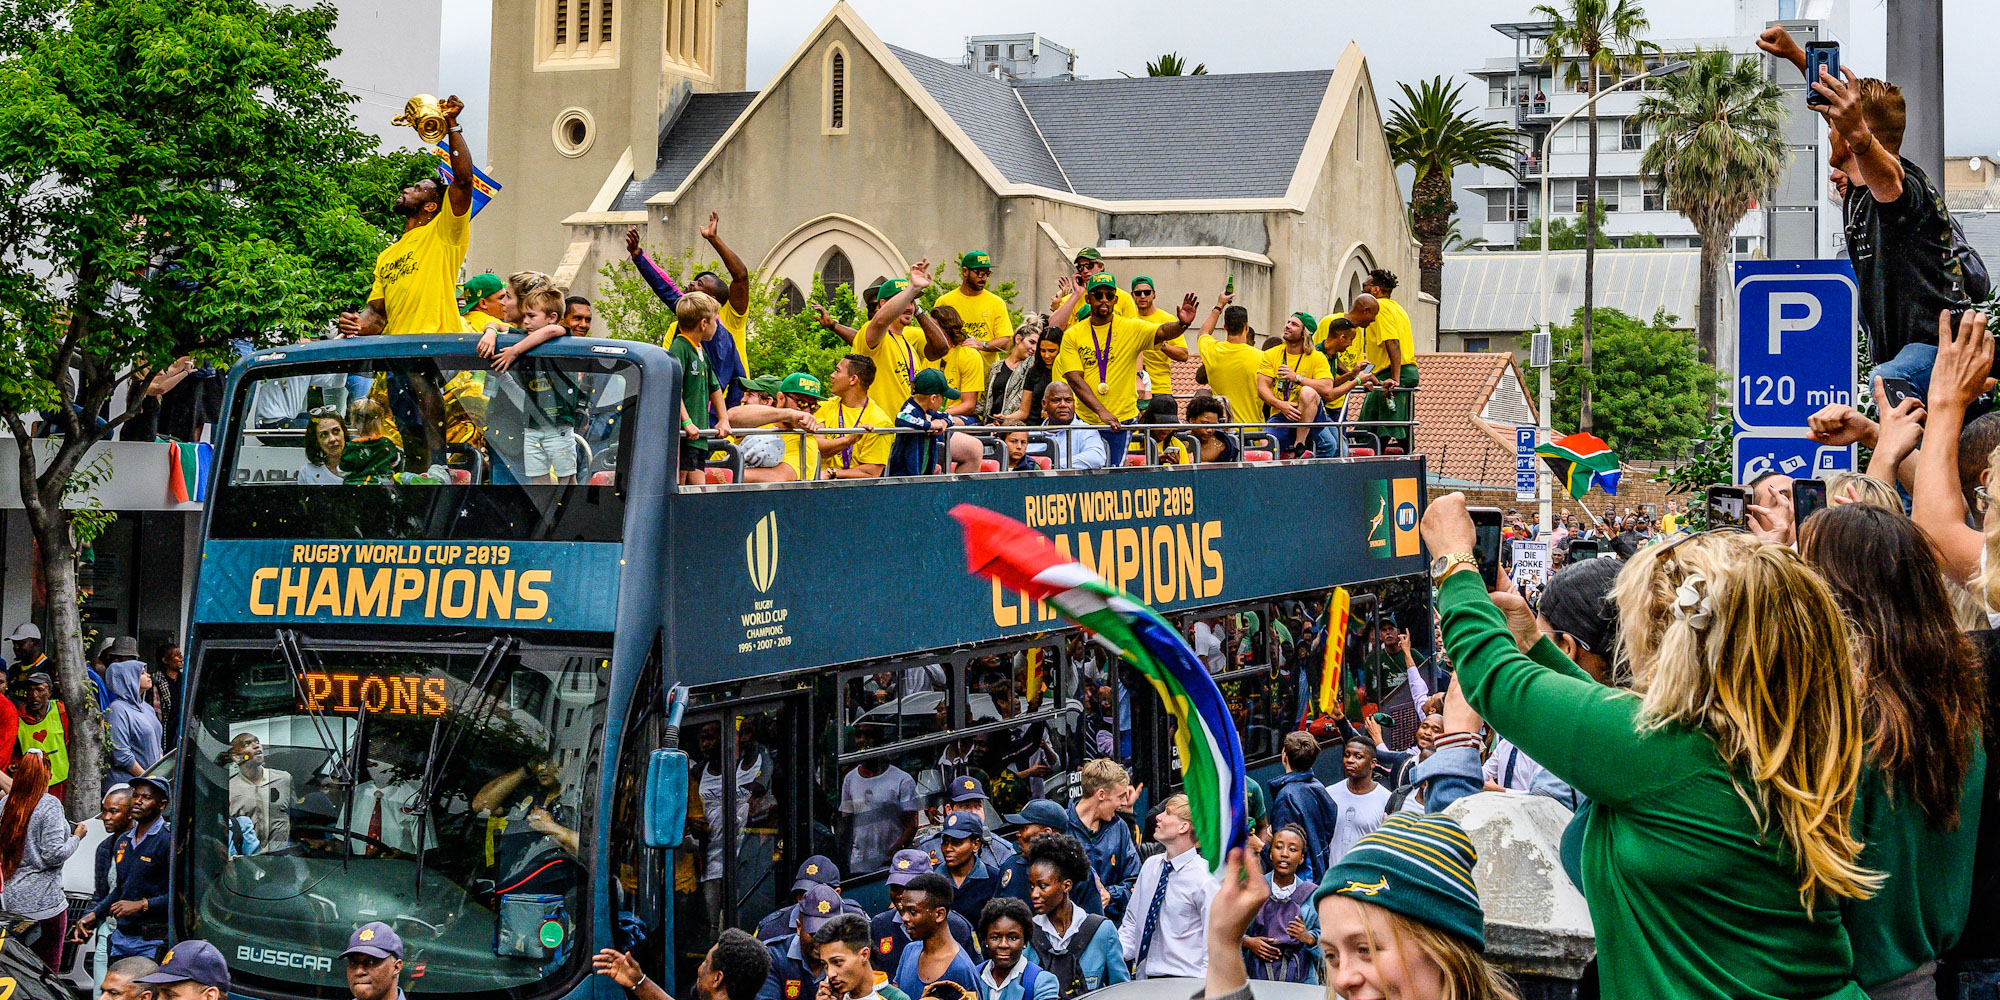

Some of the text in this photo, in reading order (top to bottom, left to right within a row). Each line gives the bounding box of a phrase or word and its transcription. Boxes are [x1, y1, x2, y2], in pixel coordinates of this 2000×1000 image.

[1768, 291, 1822, 355] P
[1740, 375, 1850, 406] 120 min
[1521, 431, 1532, 444] P
[1025, 486, 1194, 527] RUGBY WORLD CUP 2019
[1399, 507, 1414, 525] MTN
[292, 544, 511, 565] RUGBY WORLD CUP 2019
[1524, 551, 1537, 559] DIE
[250, 567, 553, 620] CHAMPIONS
[754, 600, 774, 610] RUGBY
[741, 609, 788, 627] WORLD CUP
[746, 625, 784, 639] CHAMPIONS
[738, 636, 792, 653] 1995 2007 2019
[299, 673, 447, 715] PIONS
[1070, 771, 1082, 784] EXIT
[236, 945, 332, 973] BUSSCAR
